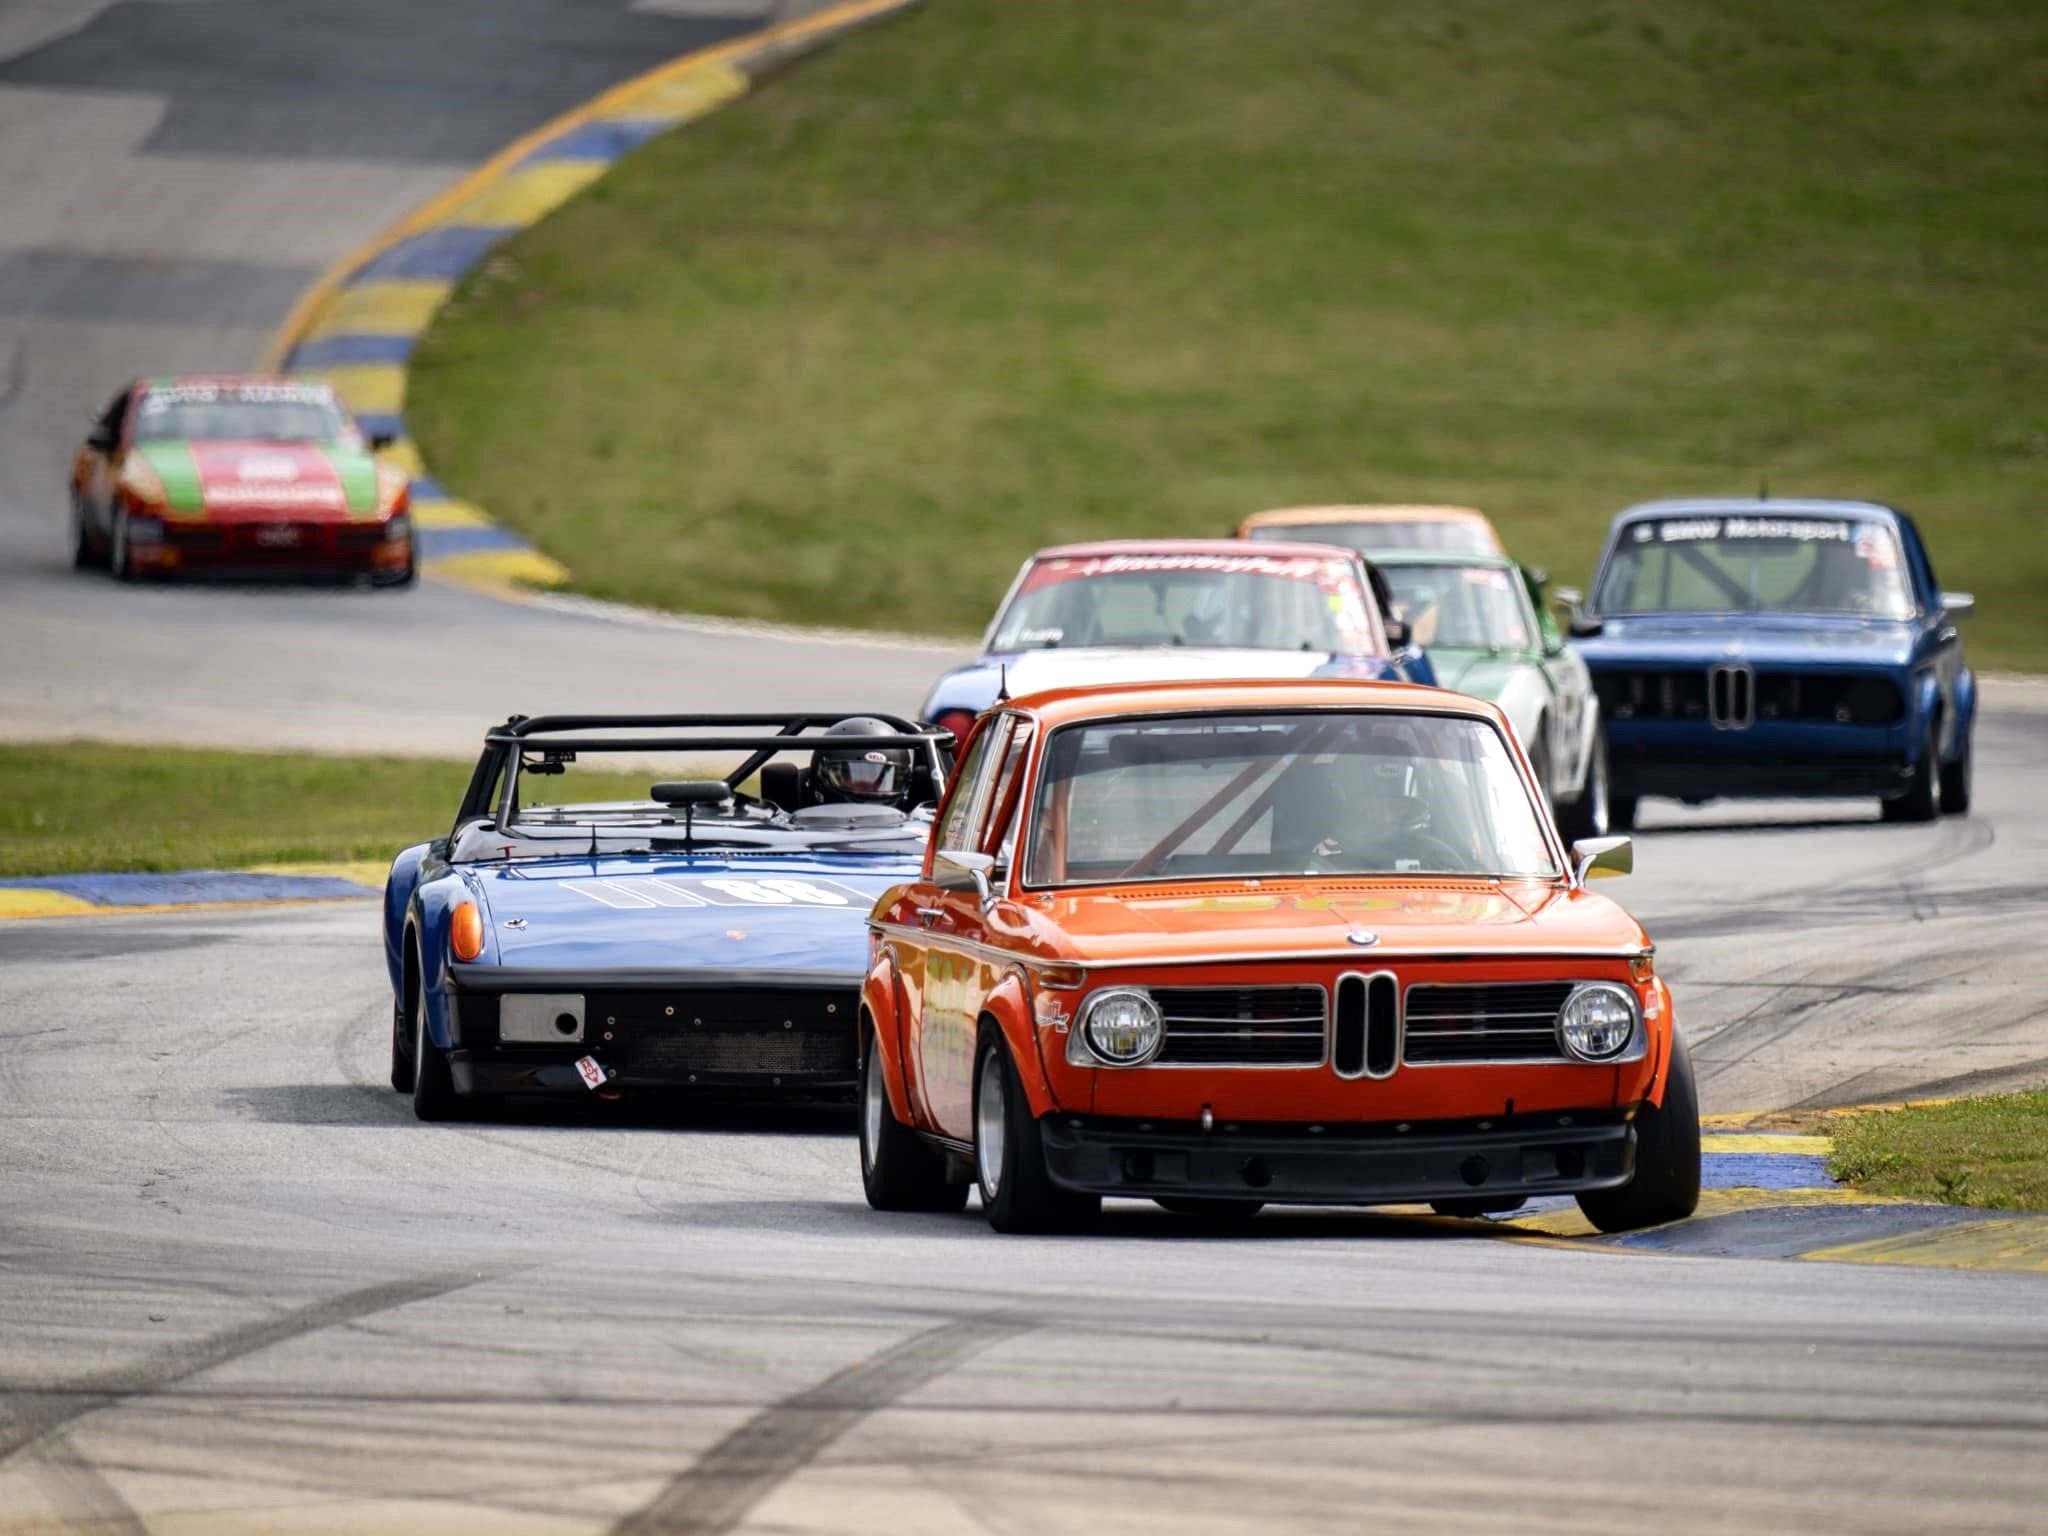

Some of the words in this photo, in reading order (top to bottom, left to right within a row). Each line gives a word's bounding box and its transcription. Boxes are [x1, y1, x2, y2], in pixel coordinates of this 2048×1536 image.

[1661, 519, 1721, 541] BMW
[1724, 518, 1849, 541] Motorsport
[701, 879, 849, 905] 88
